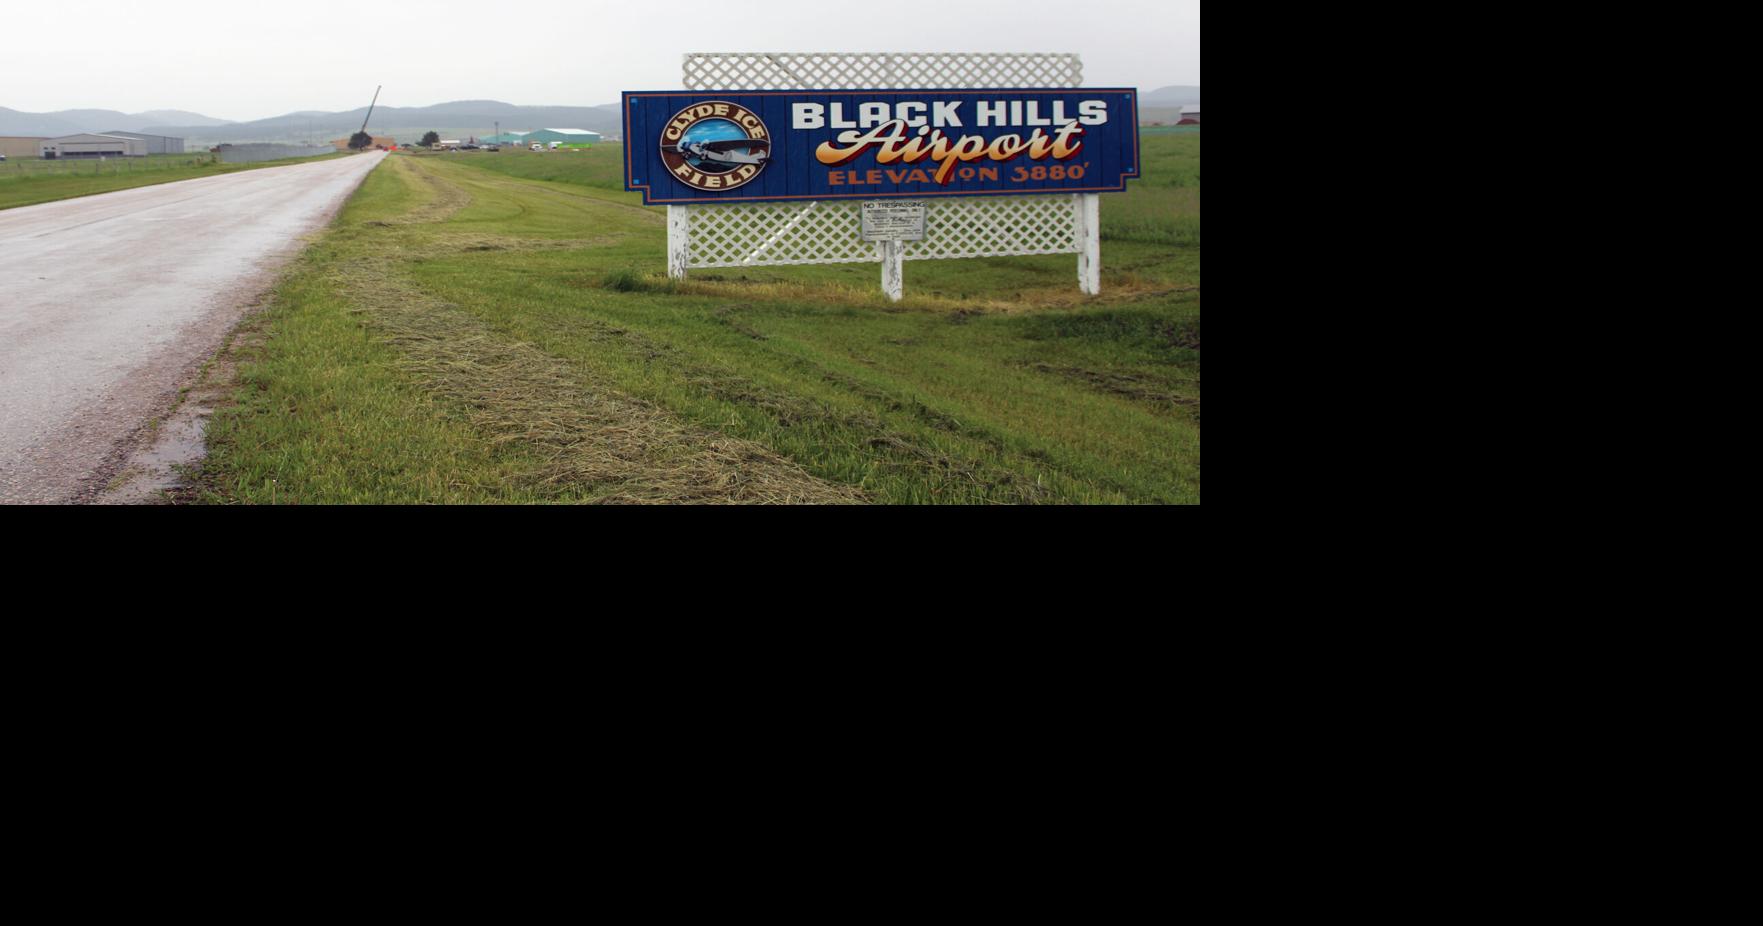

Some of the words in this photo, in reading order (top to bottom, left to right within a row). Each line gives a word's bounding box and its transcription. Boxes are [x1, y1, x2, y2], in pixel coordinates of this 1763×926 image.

[666, 104, 730, 141] CLYDE
[733, 109, 766, 140] ICE
[791, 101, 963, 130] BLACK
[977, 100, 1108, 127] HILLS
[815, 118, 1087, 186] Airport
[674, 163, 757, 188] FIELD
